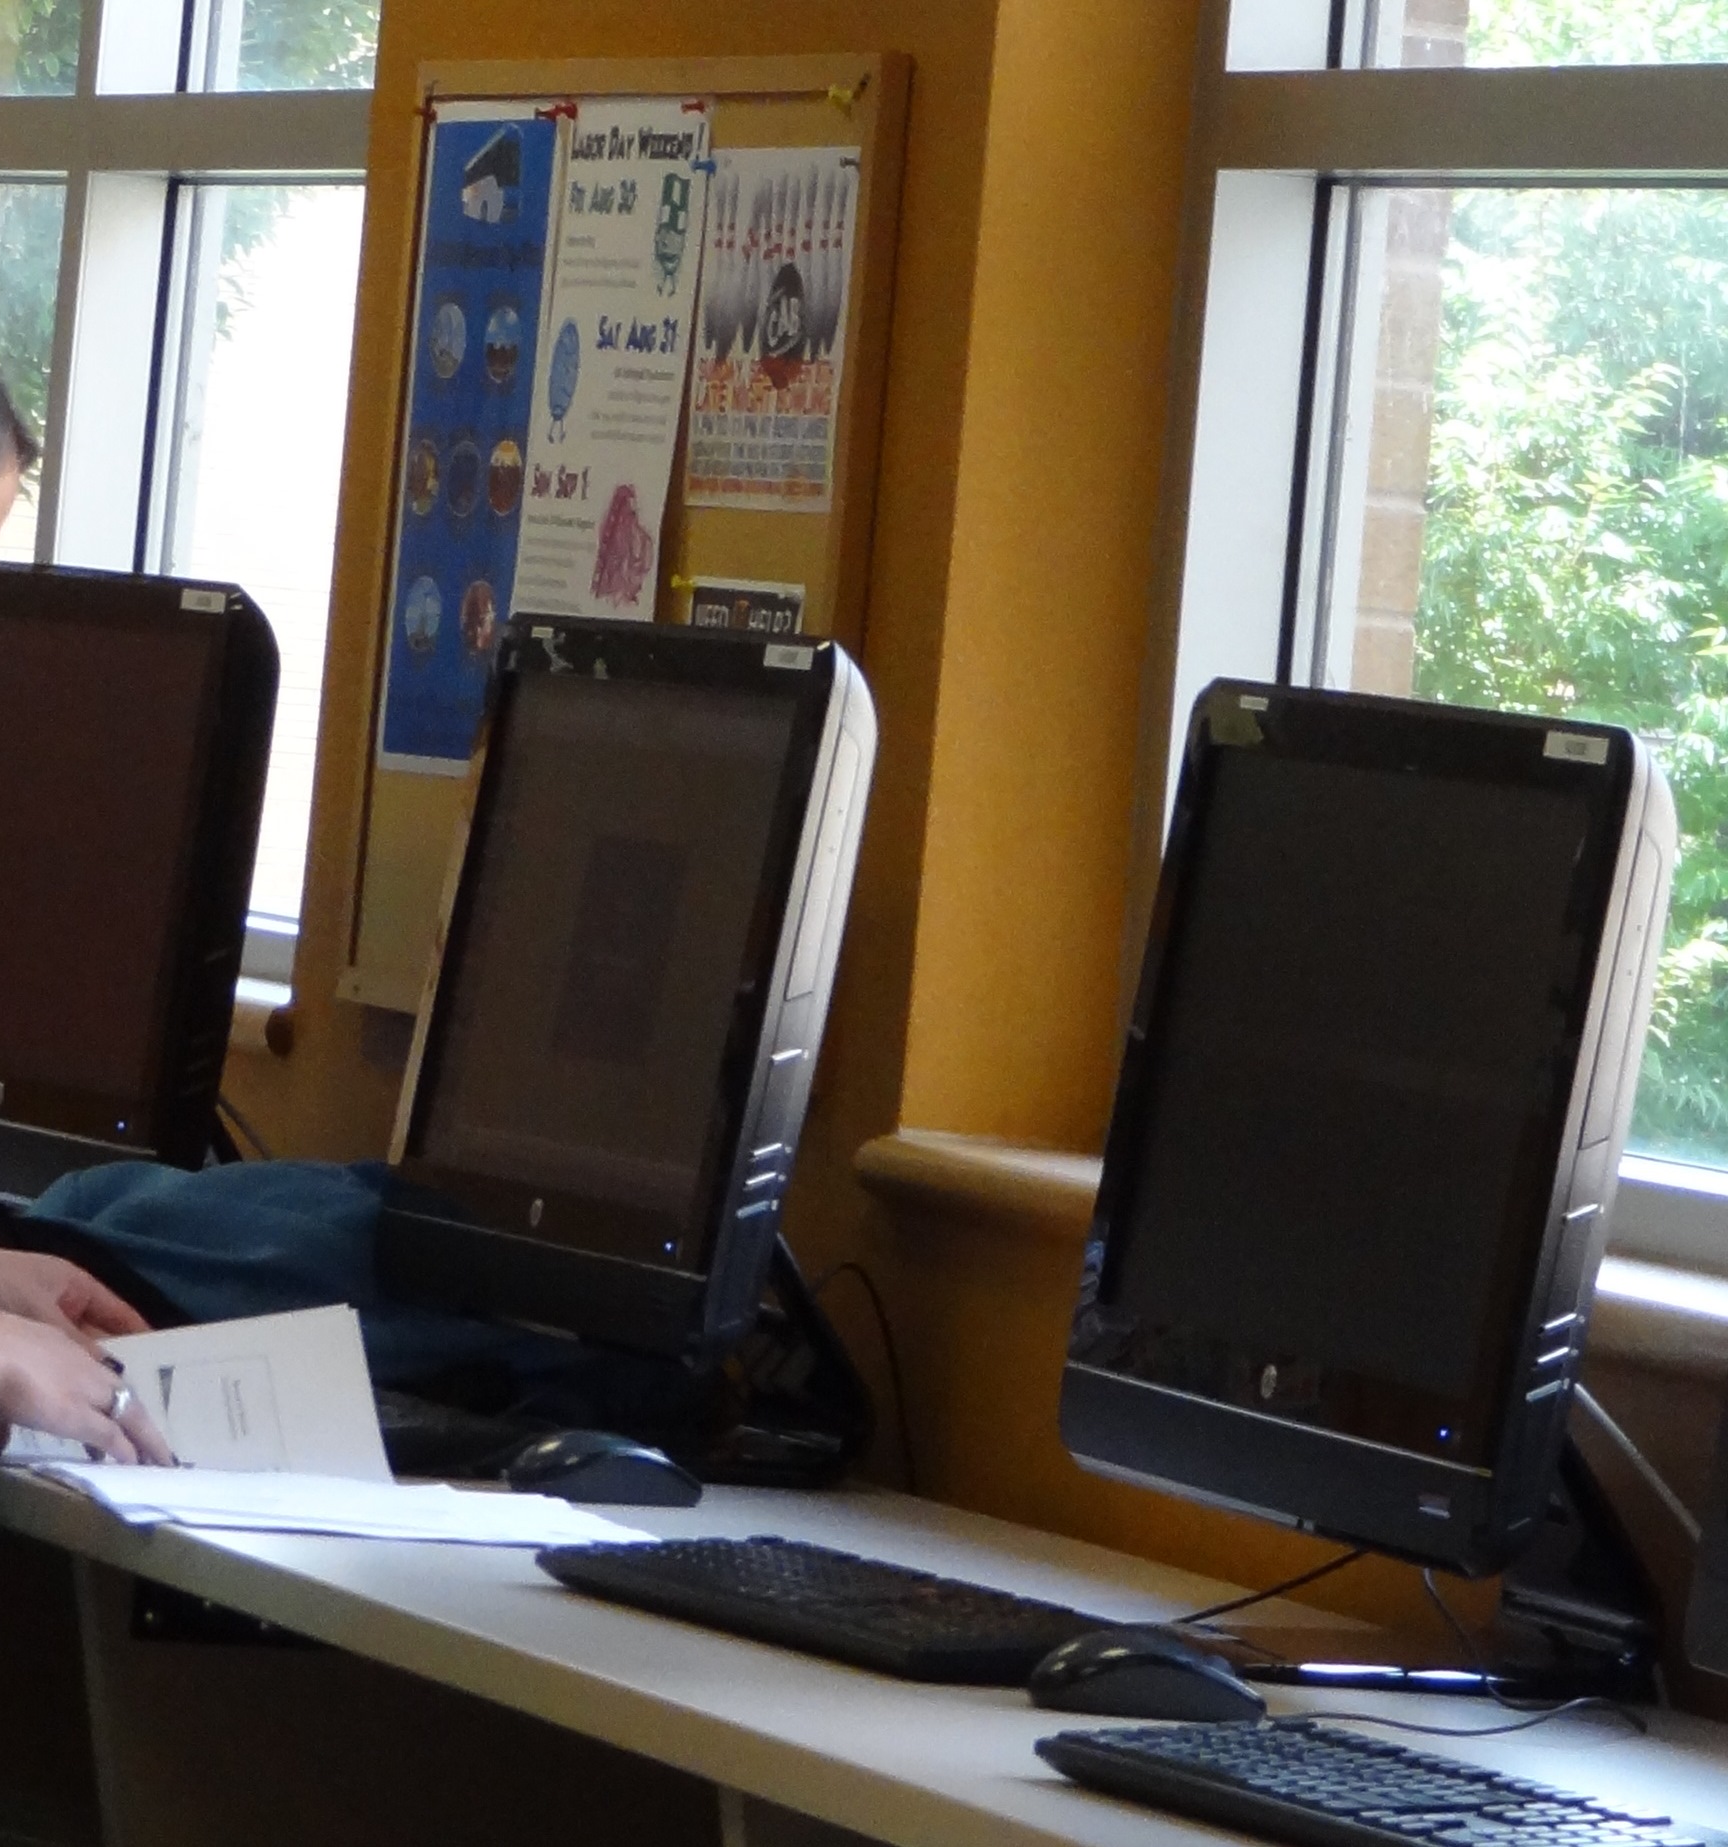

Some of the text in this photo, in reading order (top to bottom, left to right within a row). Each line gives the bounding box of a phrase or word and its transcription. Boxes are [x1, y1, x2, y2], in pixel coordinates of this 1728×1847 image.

[608, 125, 636, 160] DAY
[588, 181, 616, 214] AUG
[596, 315, 678, 353] SAT AUG 31
